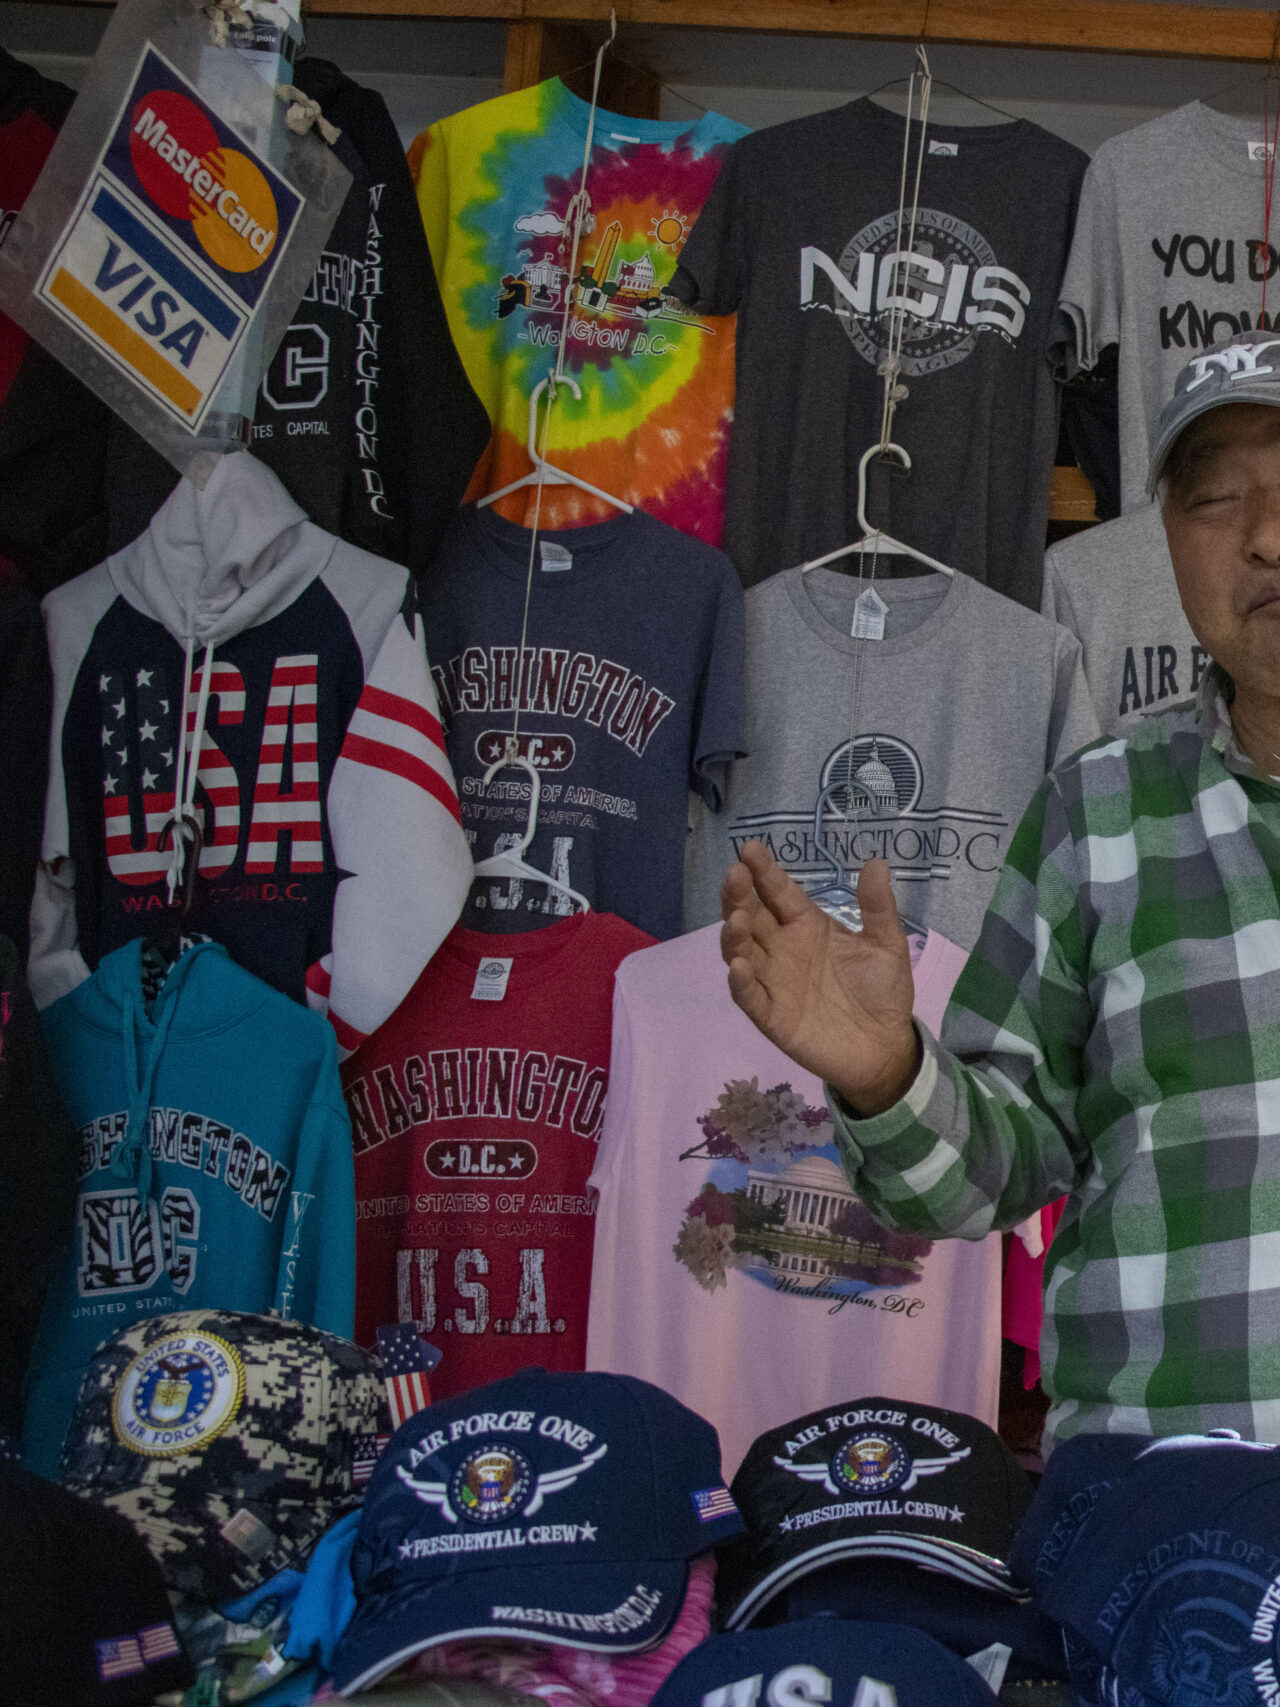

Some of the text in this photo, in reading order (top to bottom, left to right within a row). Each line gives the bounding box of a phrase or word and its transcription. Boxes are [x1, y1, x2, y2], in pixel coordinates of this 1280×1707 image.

[134, 108, 275, 256] MasterCard
[1151, 233, 1235, 284] YOU
[95, 235, 206, 369] VISA
[800, 245, 1032, 339] NCIS
[356, 184, 386, 461] WASHINGTON
[287, 421, 331, 436] CAPITAL
[1118, 645, 1179, 717] AIR
[99, 653, 324, 887] USA
[539, 784, 561, 803] OF
[564, 786, 638, 822] AMERICA
[934, 826, 1002, 874] D.C.
[458, 1145, 506, 1174] D.C.
[415, 1193, 490, 1214] STATES
[495, 1193, 525, 1214] OF
[76, 1186, 200, 1298] DC
[493, 1222, 577, 1238] CAPITAL
[773, 1274, 926, 1318] Washington, DC
[136, 1338, 230, 1378] UNITED STATES
[126, 1419, 206, 1444] AIR FORCE
[409, 1410, 597, 1468] AIR FORCE ONE
[784, 1408, 961, 1456] AIR FORCE ONE
[795, 1499, 950, 1530] PRESIDENTIAL CREW
[413, 1523, 579, 1559] PRESIDENTIAL CREW
[1097, 1528, 1231, 1635] PRESIDENT
[1231, 1539, 1266, 1564] OF
